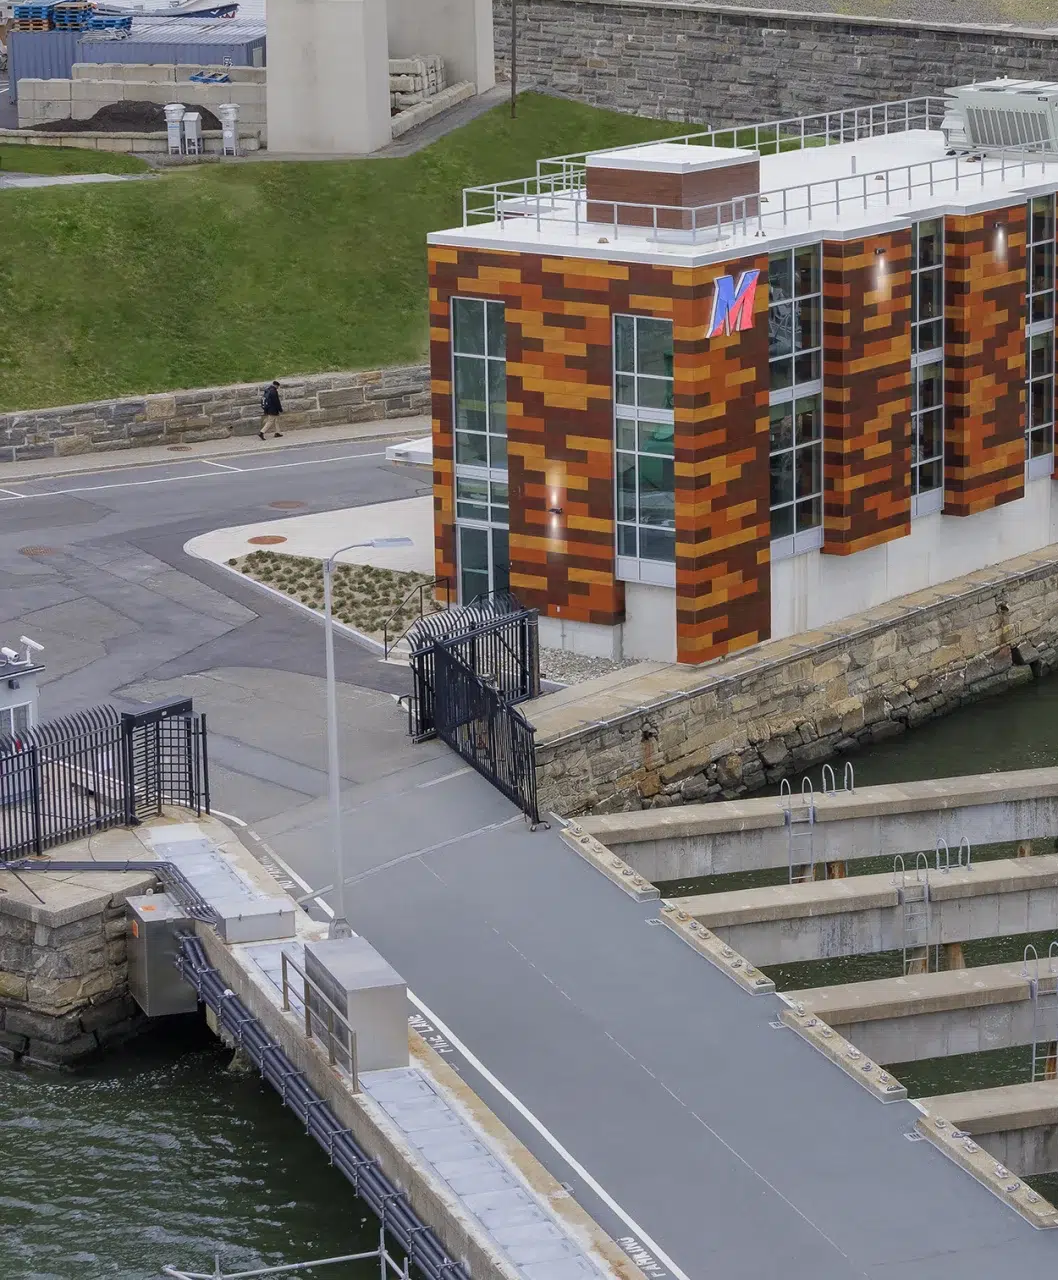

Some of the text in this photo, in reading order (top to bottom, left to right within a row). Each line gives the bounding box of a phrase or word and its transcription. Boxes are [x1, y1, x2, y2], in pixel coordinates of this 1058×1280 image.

[705, 269, 760, 338] M
[408, 1014, 453, 1054] FIRE LANE
